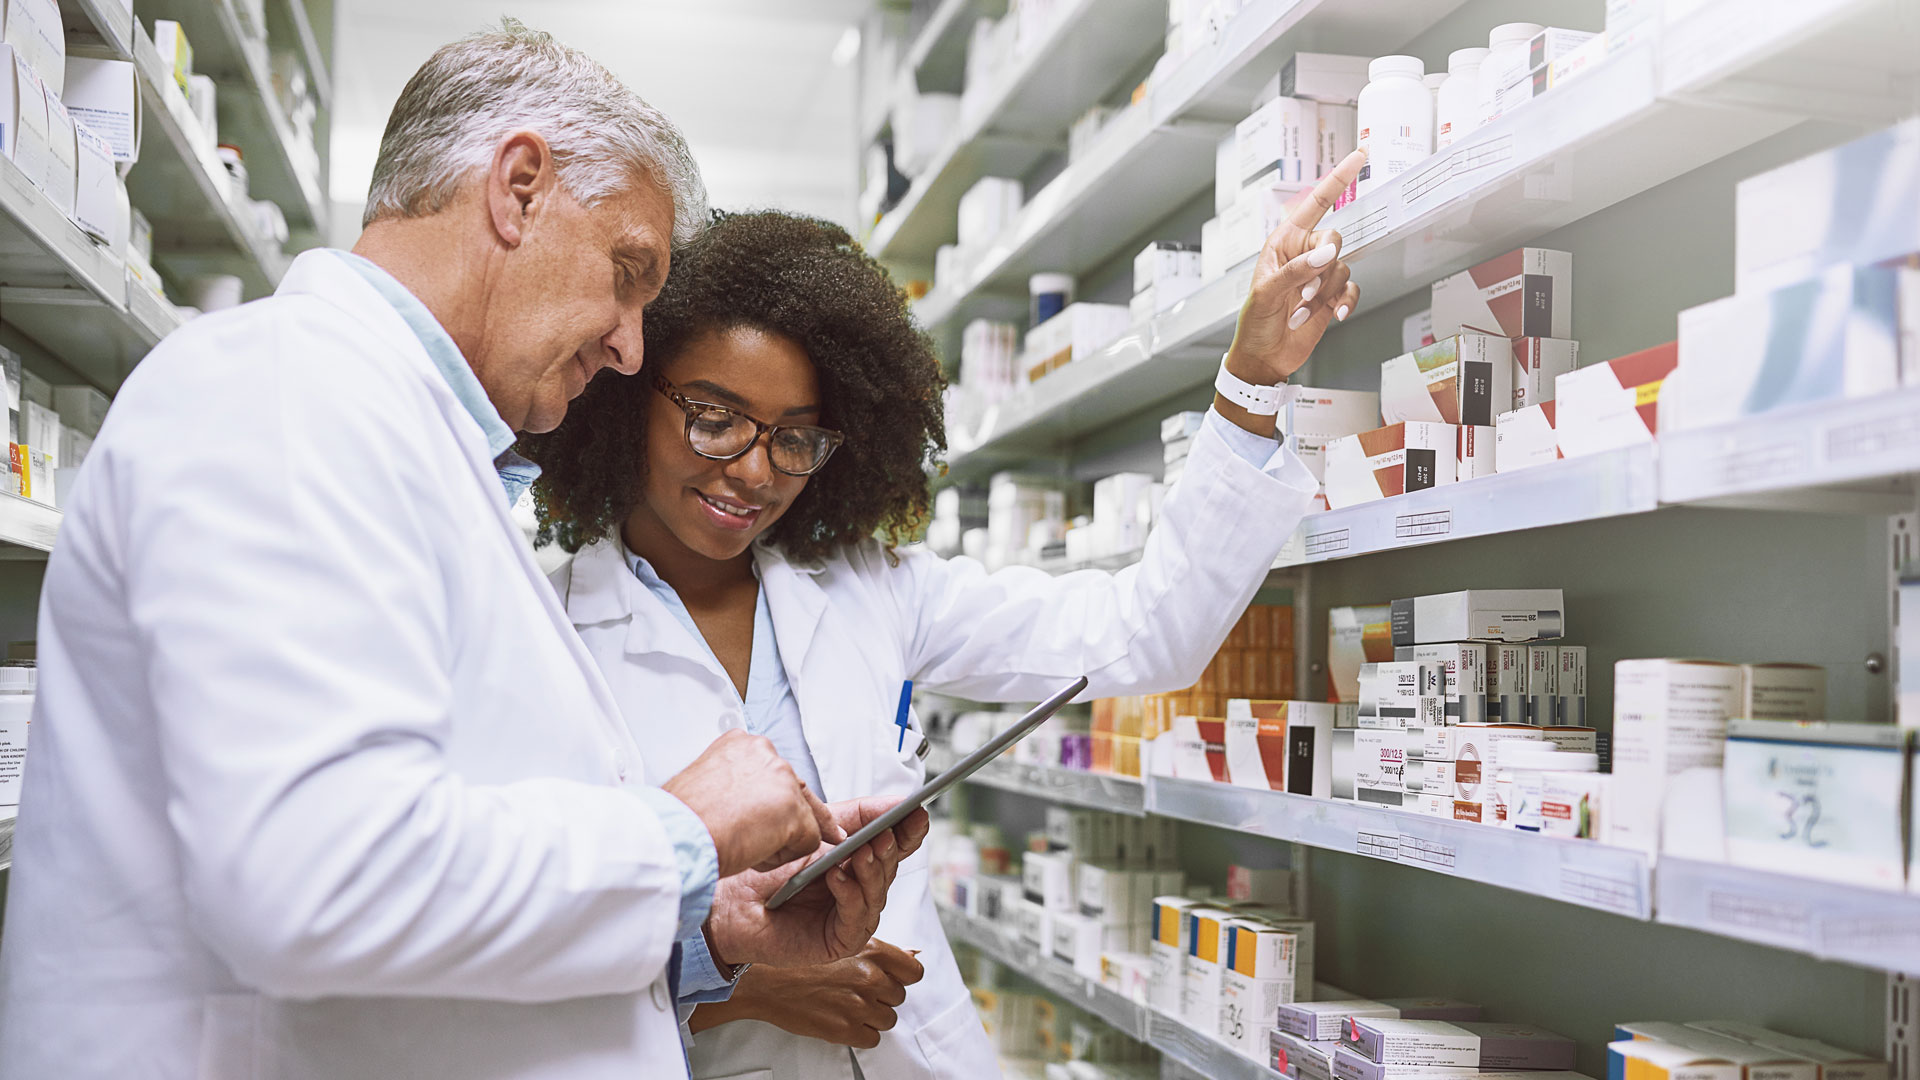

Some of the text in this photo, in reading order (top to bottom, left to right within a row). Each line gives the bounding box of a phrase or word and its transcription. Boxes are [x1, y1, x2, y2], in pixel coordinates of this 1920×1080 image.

[10, 447, 18, 461] 25
[1398, 674, 1415, 683] 150/12.5
[1431, 675, 1437, 686] W
[1380, 748, 1403, 759] 300/12.5
[1384, 765, 1404, 775] 300/125
[1776, 790, 1830, 848] 32
